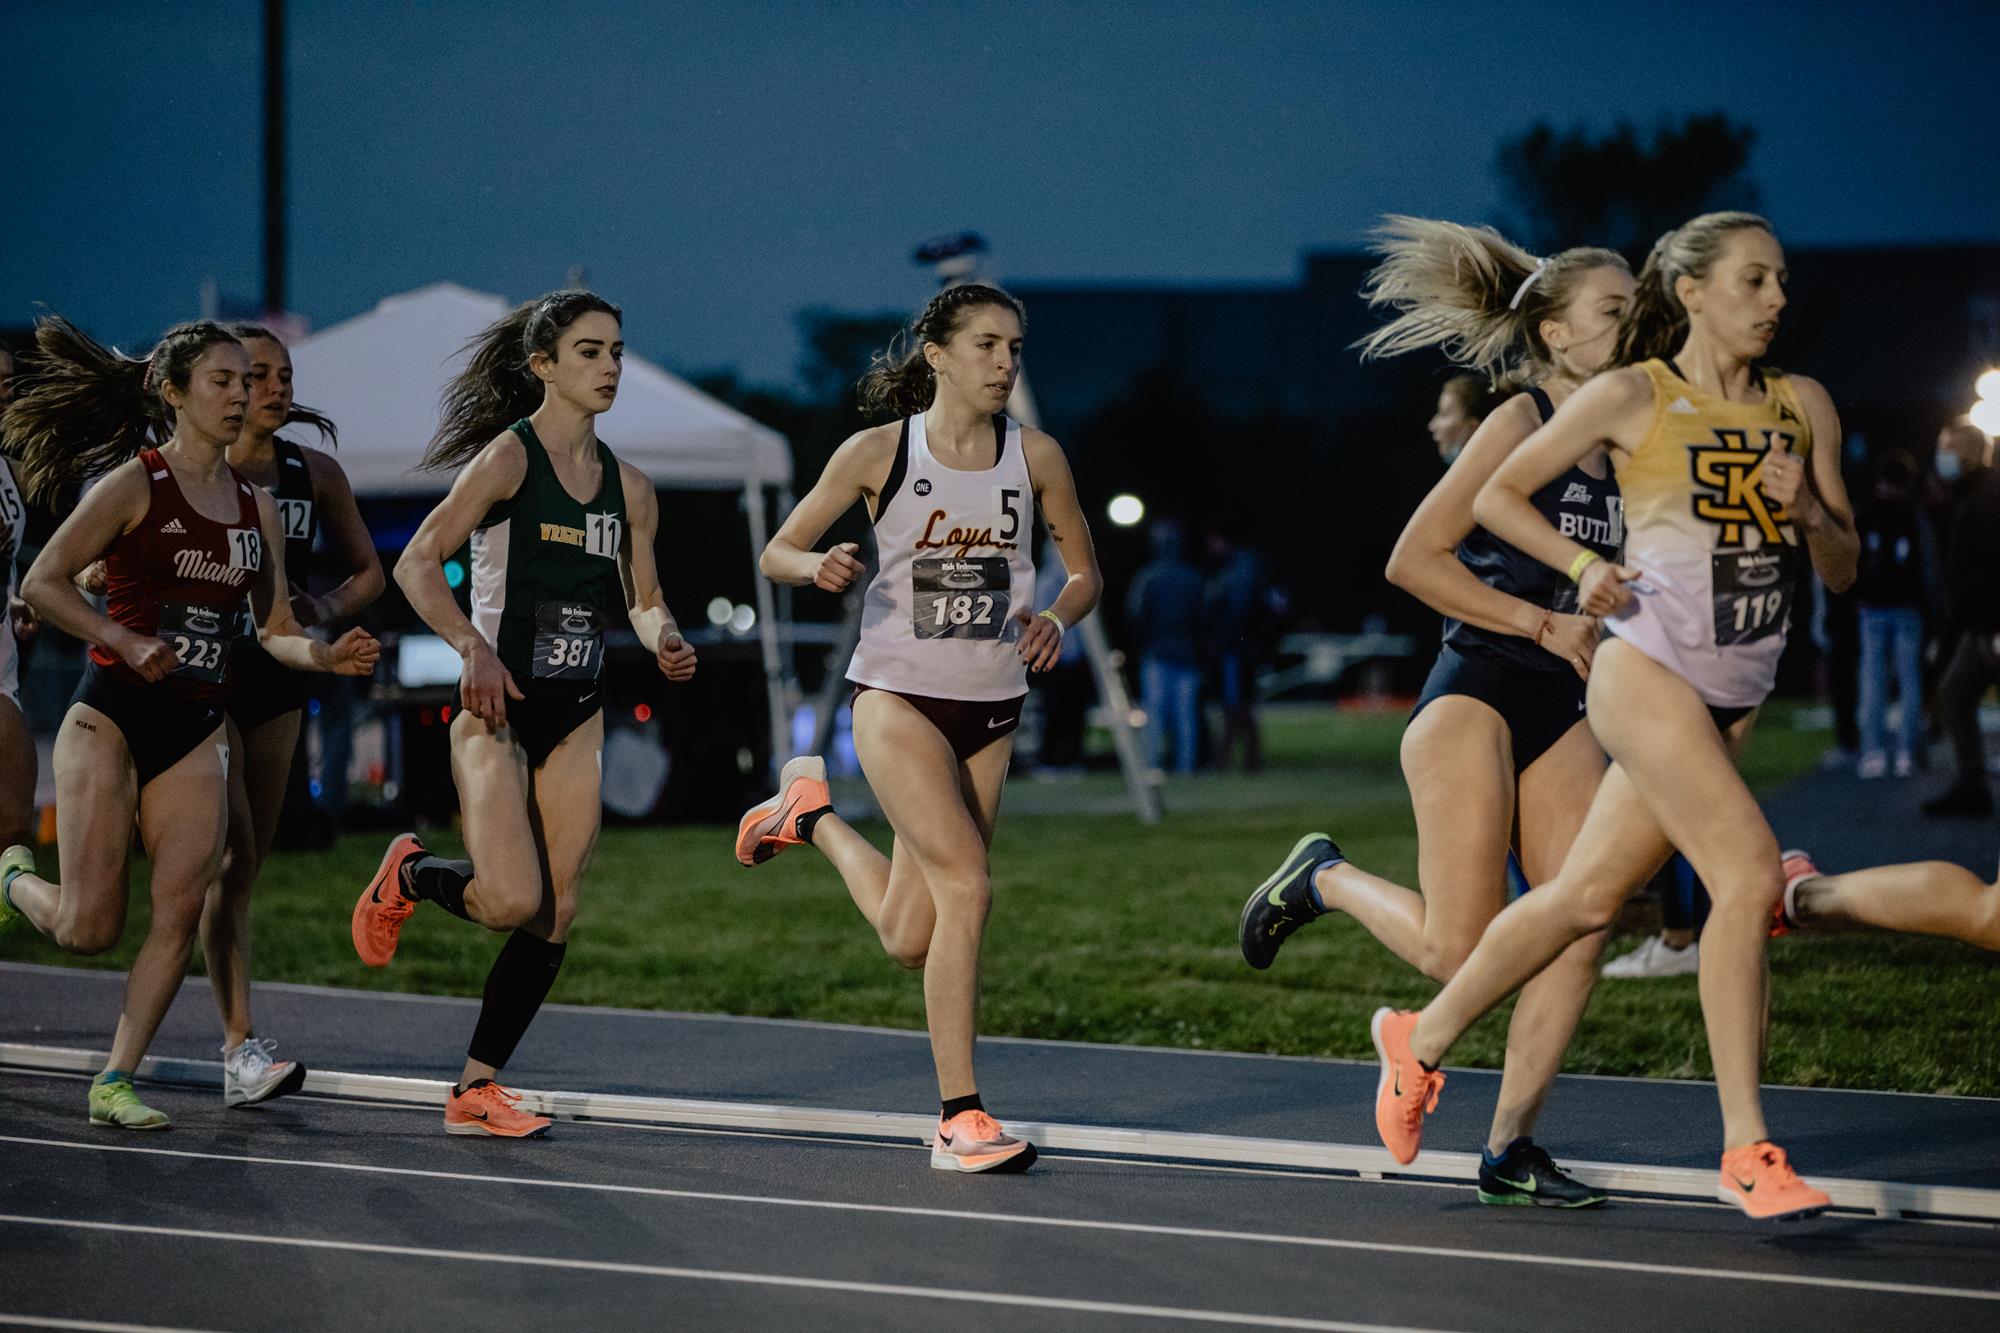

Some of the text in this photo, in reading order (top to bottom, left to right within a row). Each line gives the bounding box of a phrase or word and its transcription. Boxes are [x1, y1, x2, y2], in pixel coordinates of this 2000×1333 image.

[915, 482, 930, 493] ONE
[1563, 490, 1593, 503] EAST
[160, 526, 187, 534] adidas
[279, 501, 306, 536] 12
[1000, 488, 1020, 540] 5
[235, 532, 258, 568] 18
[540, 523, 586, 547] WRIGHT
[594, 517, 616, 556] 11
[173, 549, 246, 587] Miami
[932, 595, 994, 625] 182
[1733, 590, 1783, 631] 119
[174, 635, 222, 670] 223
[75, 719, 97, 732] MIAMI
